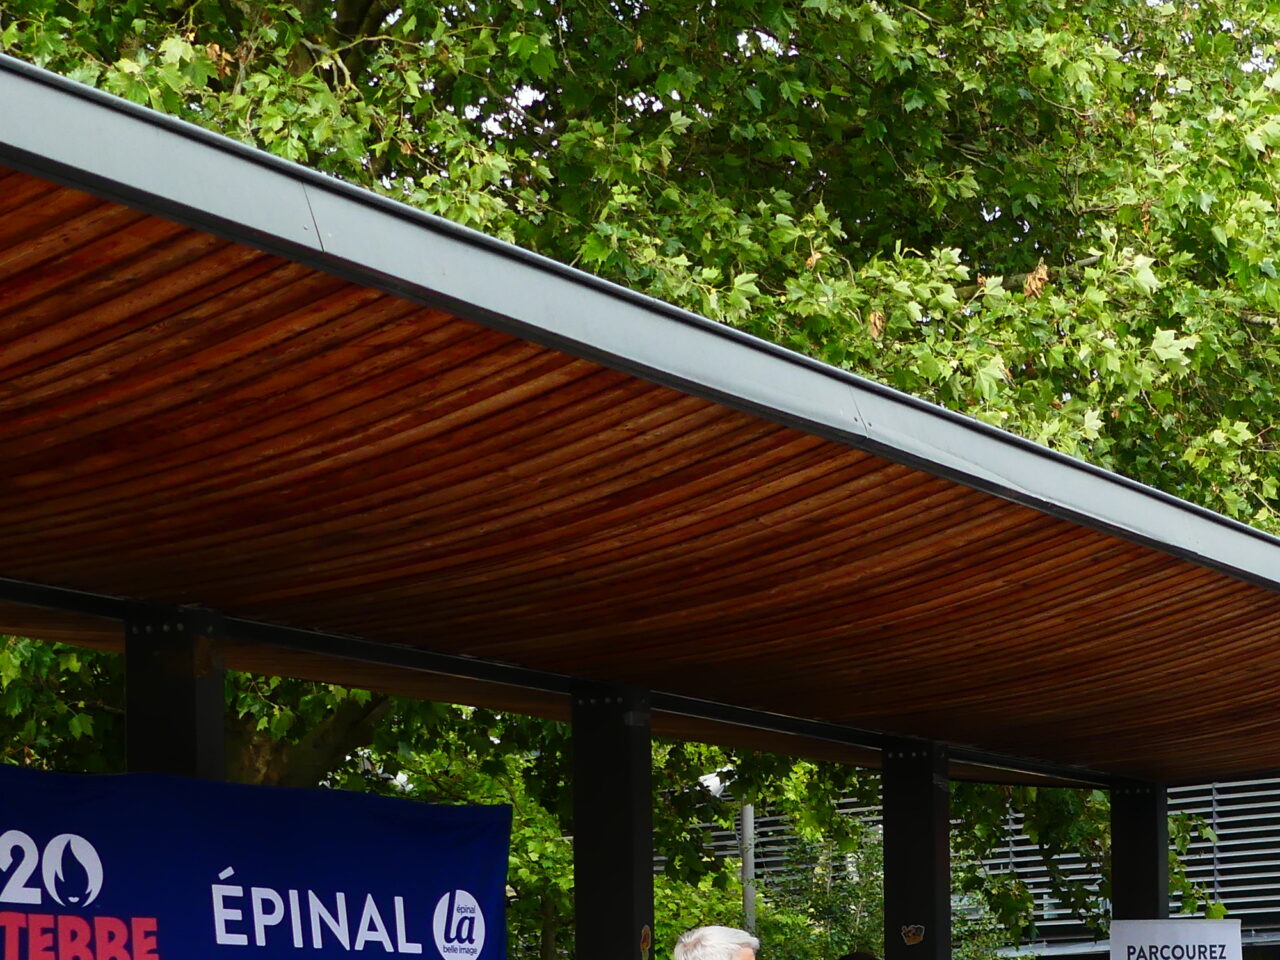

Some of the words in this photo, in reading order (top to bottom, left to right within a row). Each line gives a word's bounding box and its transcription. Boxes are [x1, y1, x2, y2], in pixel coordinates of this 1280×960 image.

[0, 829, 104, 907] 20
[211, 866, 423, 954] ÉPINAL
[443, 889, 476, 944] la
[456, 904, 476, 915] épinal
[443, 945, 458, 954] belle
[459, 946, 478, 956] image
[1127, 944, 1227, 960] PARCOUREZ
